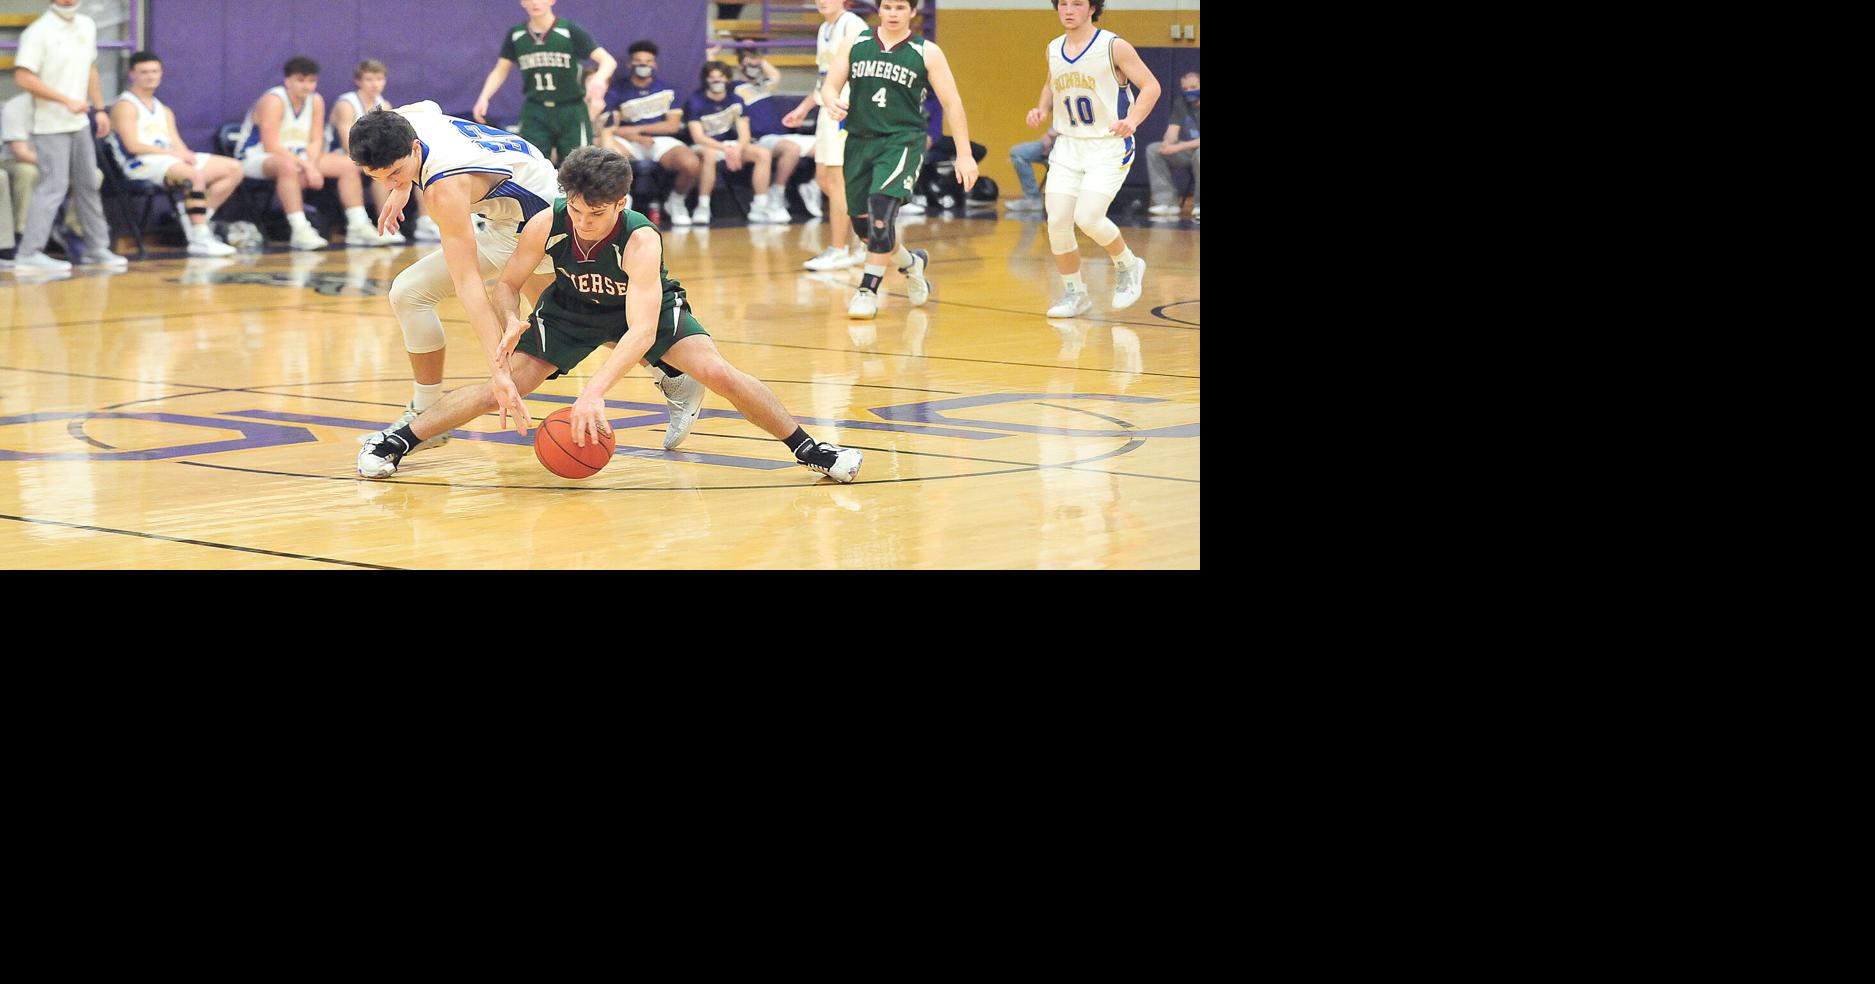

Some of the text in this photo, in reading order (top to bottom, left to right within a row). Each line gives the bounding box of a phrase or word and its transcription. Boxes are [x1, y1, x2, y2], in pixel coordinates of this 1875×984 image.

[534, 72, 557, 91] 11
[851, 60, 917, 88] SOMERSET
[871, 87, 887, 108] 4
[1063, 95, 1095, 127] 10
